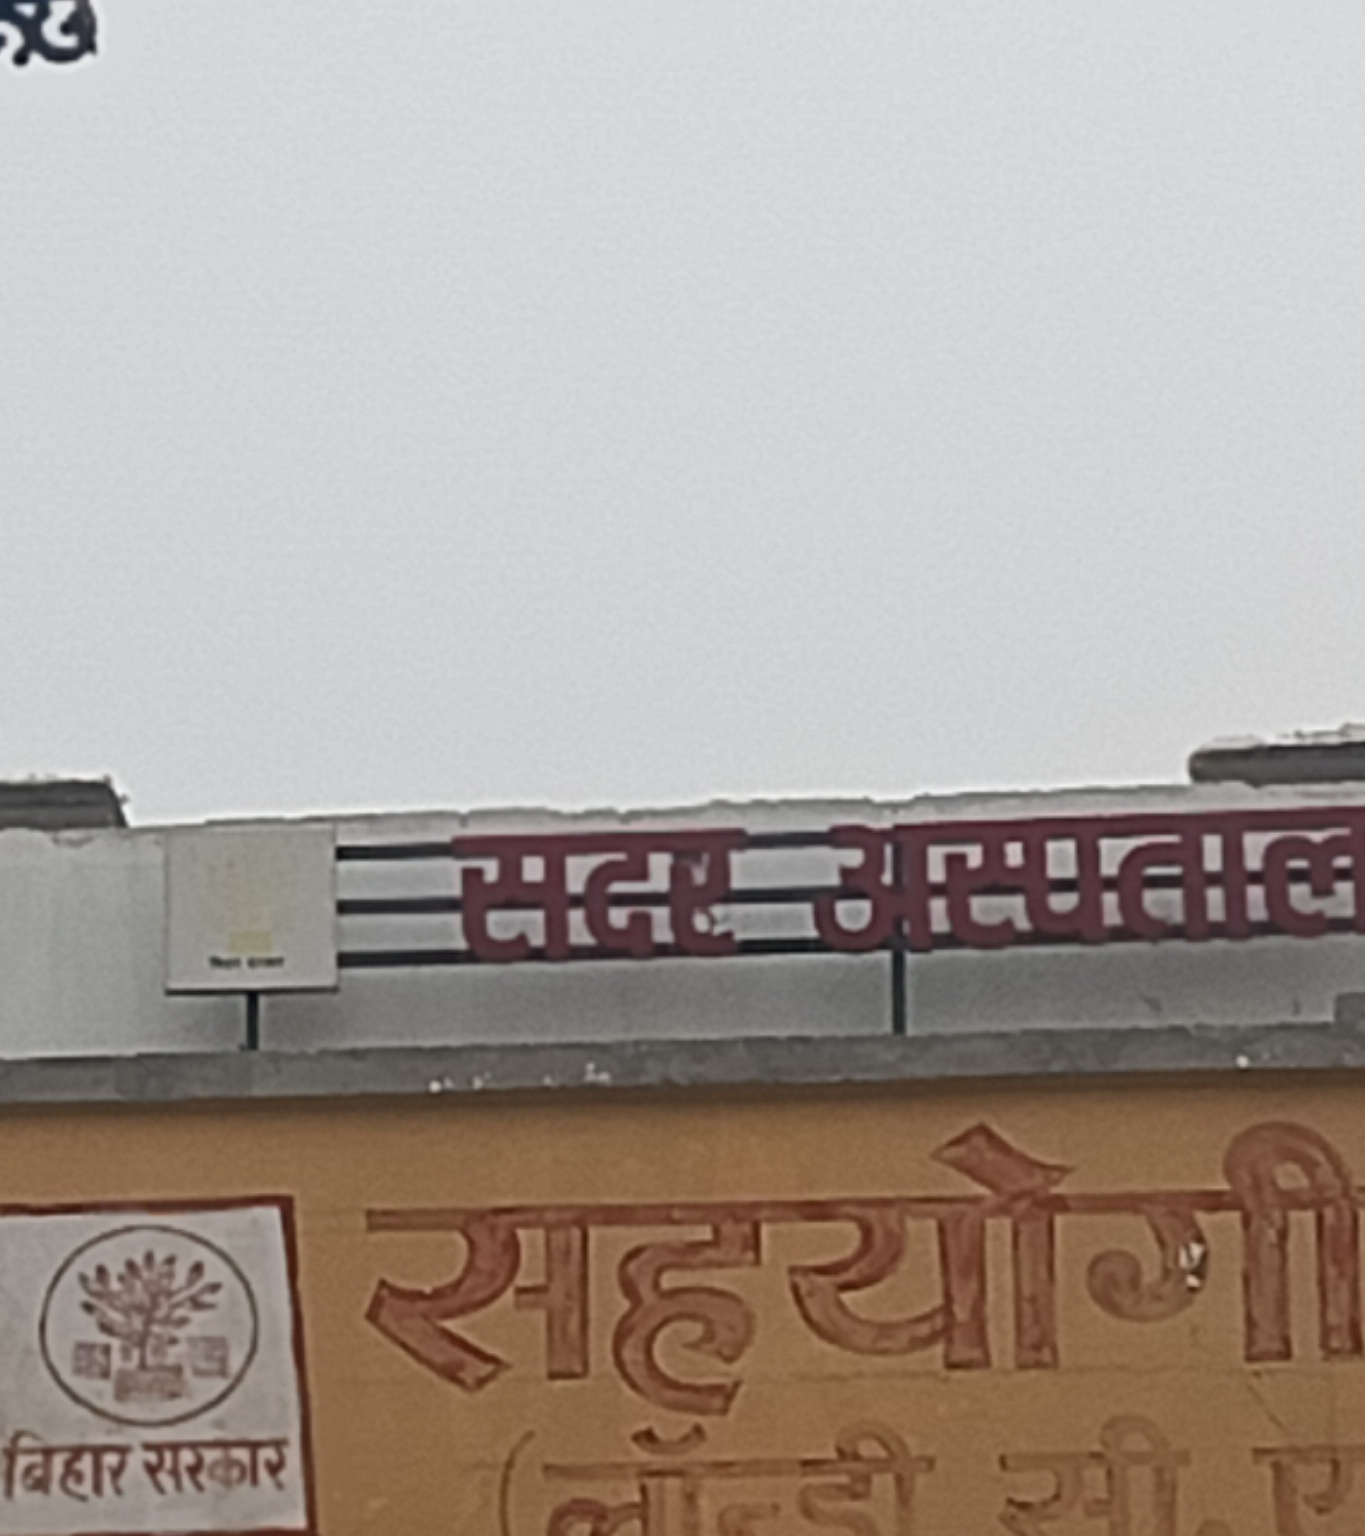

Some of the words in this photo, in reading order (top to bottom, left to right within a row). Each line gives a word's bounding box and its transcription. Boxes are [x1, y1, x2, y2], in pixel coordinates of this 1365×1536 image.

[451, 827, 747, 962] सदर
[814, 805, 1365, 952] अस्पताल
[365, 1121, 1365, 1417] सहयोगी
[2, 1430, 133, 1502] बिहार
[141, 1438, 289, 1494] सरकार
